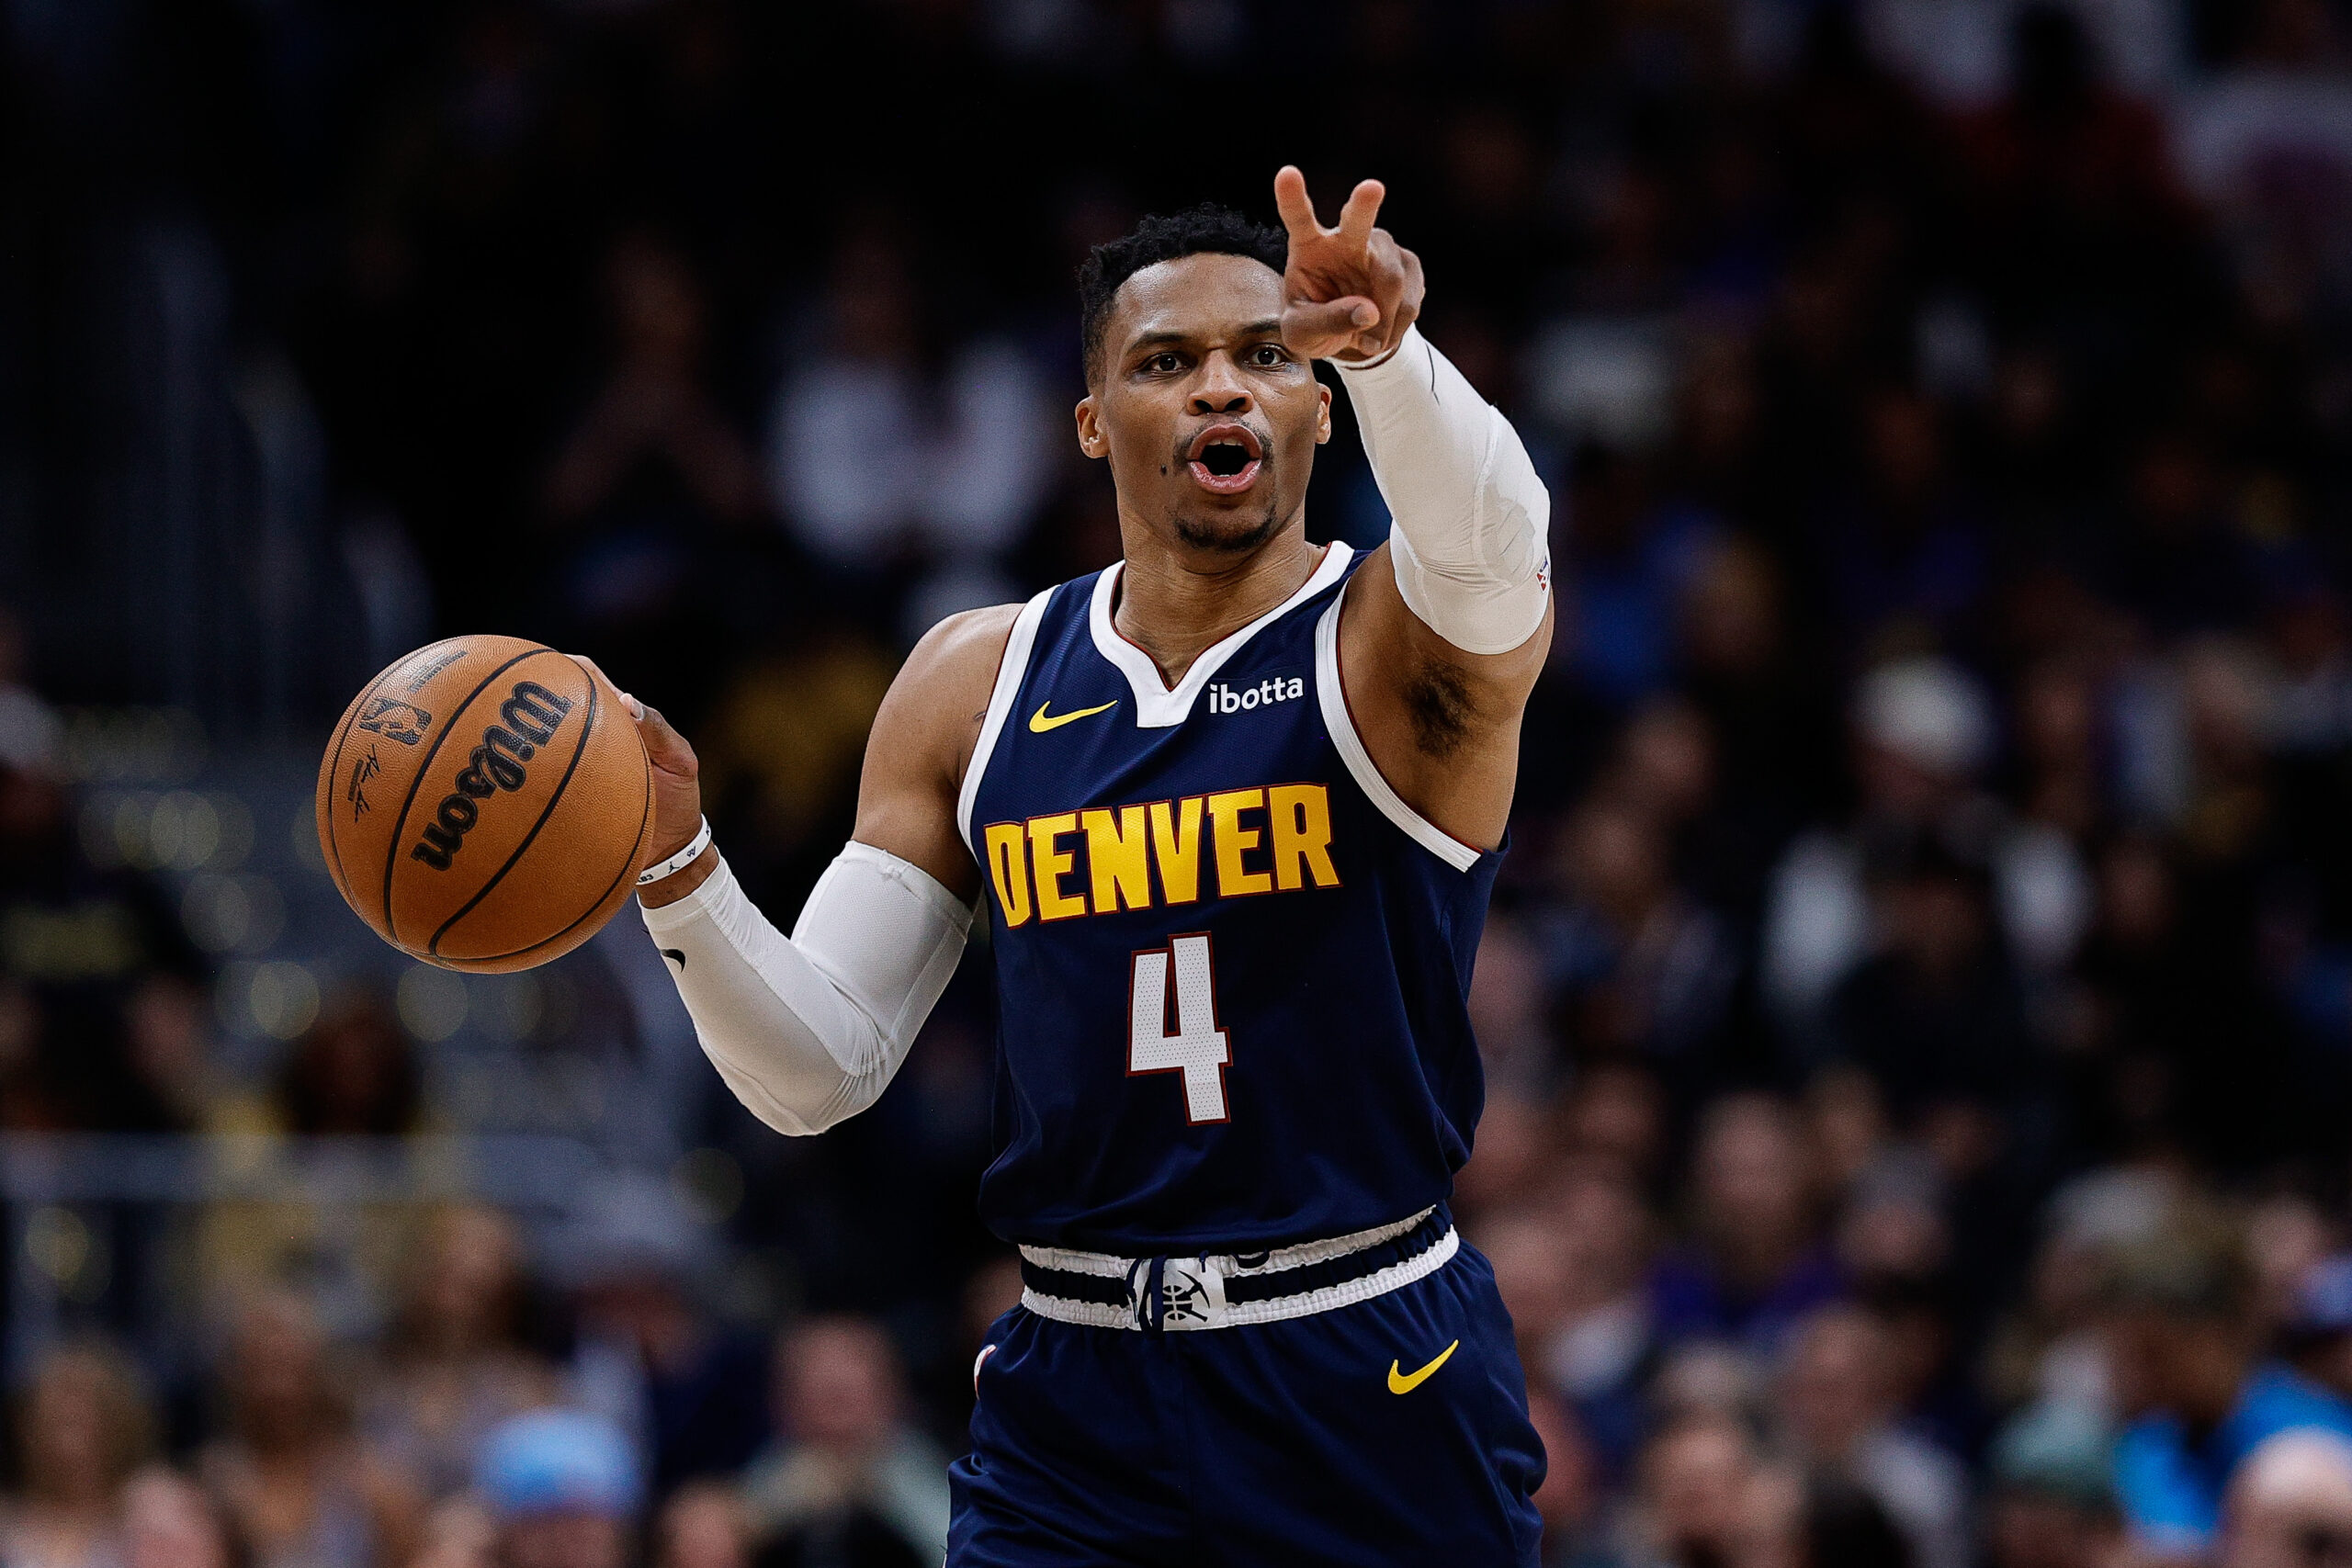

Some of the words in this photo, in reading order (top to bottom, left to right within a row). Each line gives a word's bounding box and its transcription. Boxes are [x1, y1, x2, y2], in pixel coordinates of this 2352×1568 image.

[410, 681, 573, 871] Wilson
[1209, 676, 1304, 714] ibotta
[983, 783, 1343, 929] DENVER
[1125, 931, 1233, 1125] 4
